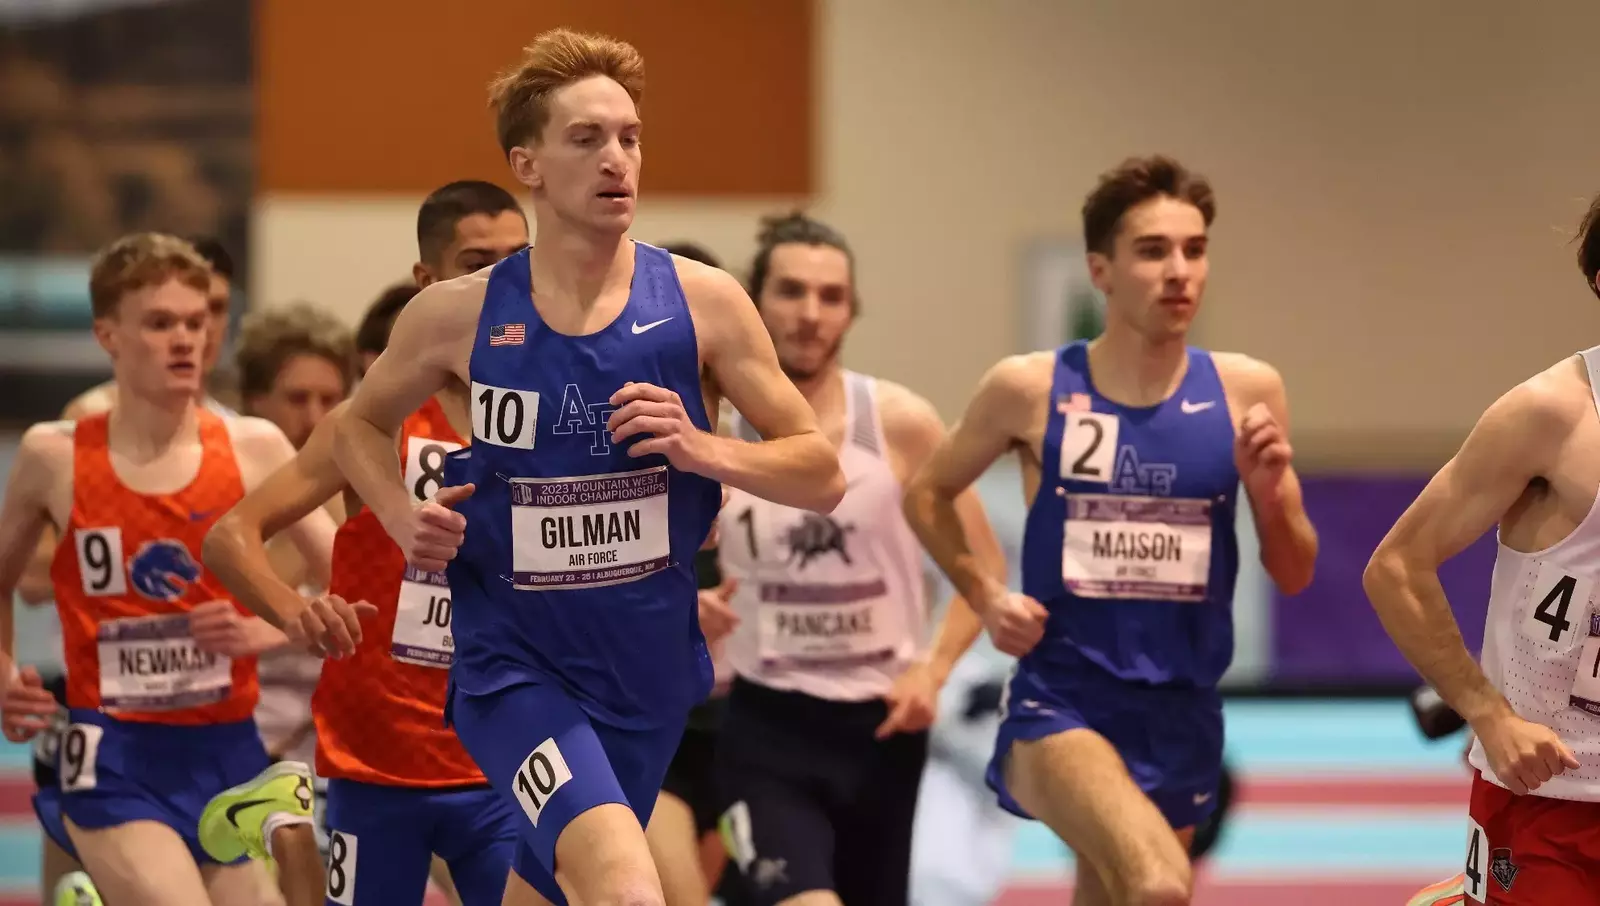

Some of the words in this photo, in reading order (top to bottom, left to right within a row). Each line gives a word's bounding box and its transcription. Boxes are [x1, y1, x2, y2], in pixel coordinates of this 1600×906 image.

[478, 388, 524, 444] 10
[414, 443, 446, 502] 8
[1072, 418, 1104, 476] 2
[1107, 444, 1177, 495] AF
[536, 494, 577, 505] INDOOR
[580, 482, 666, 502] CHAMPIONSHIPS
[541, 484, 569, 495] 2023
[572, 479, 629, 492] MOUNTAIN
[631, 474, 660, 487] WEST
[540, 509, 641, 549] GILMAN
[738, 506, 758, 559] 1
[1092, 530, 1182, 562] MAISON
[84, 532, 112, 590] 9
[530, 574, 563, 583] FEBRUARY
[565, 573, 575, 582] 23
[569, 554, 585, 566] AIR
[587, 550, 618, 563] FORCE
[776, 608, 872, 637] PANCAKE
[1533, 574, 1577, 642] 4
[67, 729, 86, 785] 9
[518, 752, 557, 811] 10
[329, 833, 347, 898] 8
[1465, 828, 1482, 896] 4
